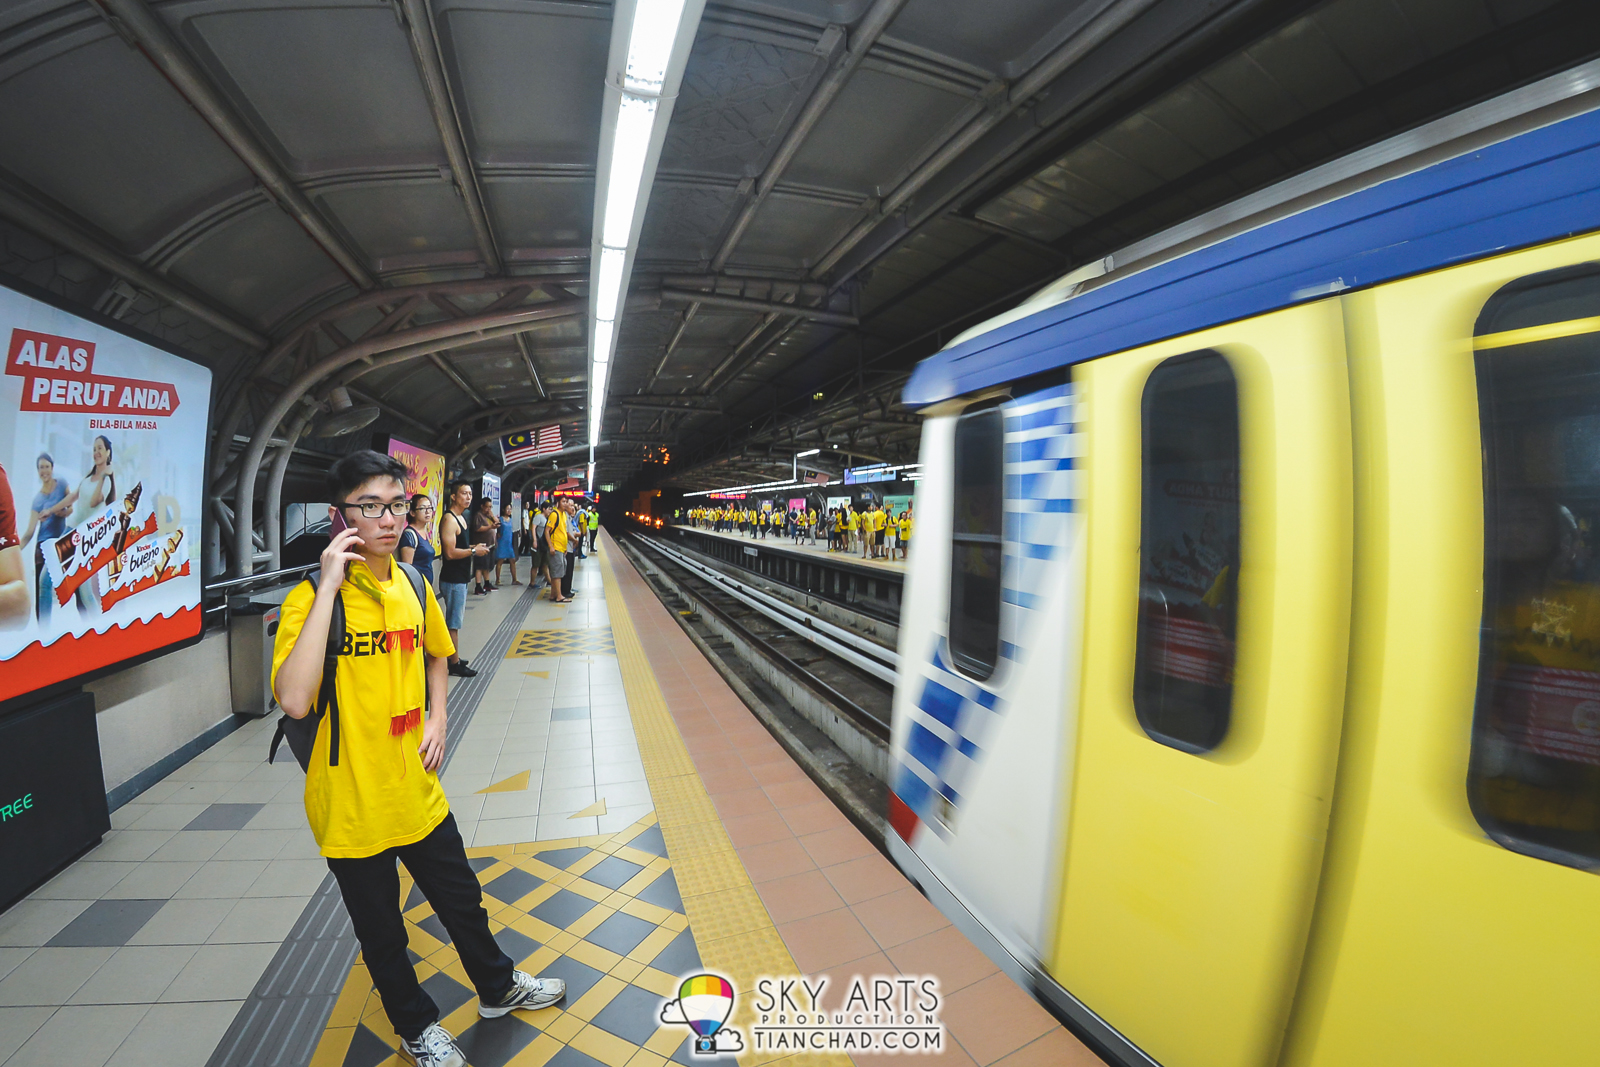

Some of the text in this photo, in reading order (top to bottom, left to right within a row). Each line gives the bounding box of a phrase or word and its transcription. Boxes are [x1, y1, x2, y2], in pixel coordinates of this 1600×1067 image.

[15, 339, 88, 373] ALAS
[31, 377, 171, 411] PERUT ANDA
[89, 419, 157, 430] BILA-BILA MASA
[82, 515, 117, 557] bueno
[129, 546, 160, 572] bueno
[0, 793, 33, 821] REE
